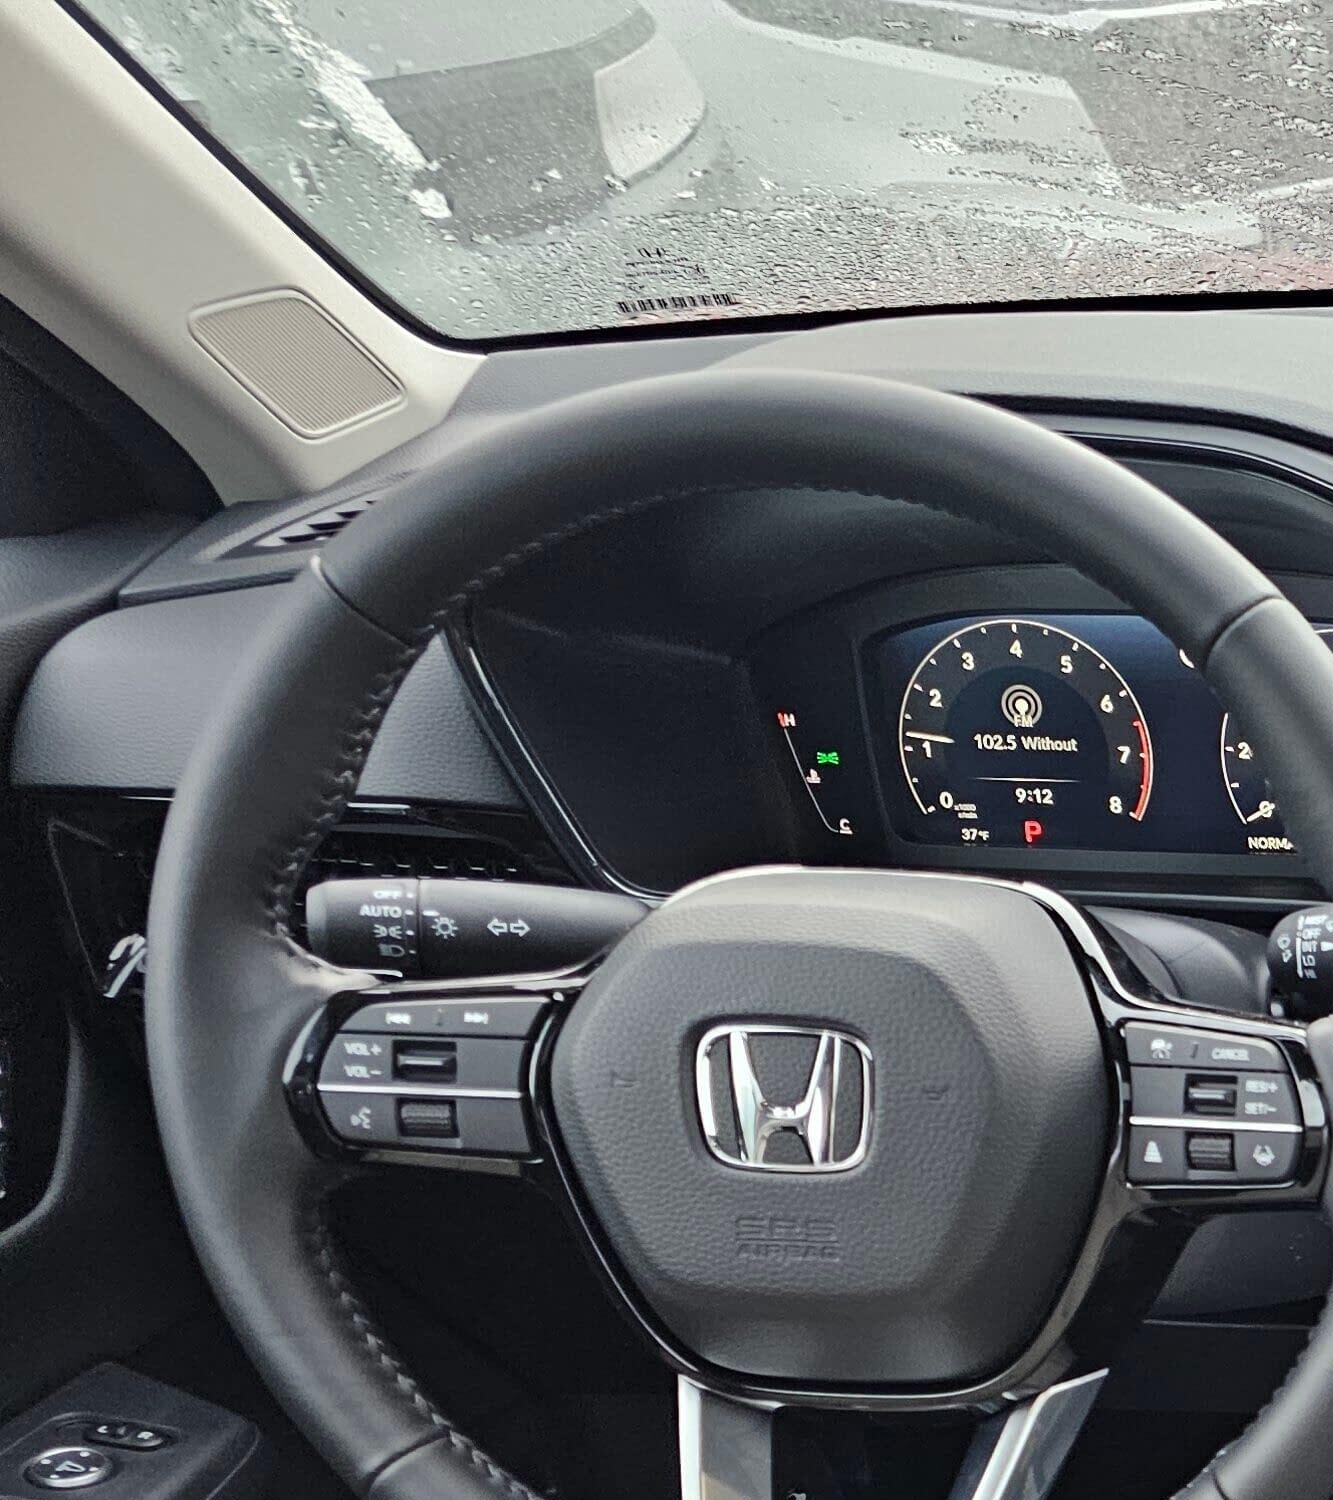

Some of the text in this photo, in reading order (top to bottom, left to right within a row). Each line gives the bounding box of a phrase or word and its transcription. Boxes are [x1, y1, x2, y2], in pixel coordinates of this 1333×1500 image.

[1009, 640, 1023, 658] 4
[961, 652, 975, 670] 3
[1060, 655, 1073, 673] 5
[929, 688, 943, 707] 2
[1100, 694, 1114, 713] 6
[1014, 714, 1034, 728] FM
[922, 741, 932, 758] 1
[974, 733, 1079, 753] 102.5 Without
[1117, 745, 1131, 764] 7
[939, 791, 954, 809] 0
[1015, 787, 1054, 805] 9:12
[1109, 796, 1123, 814] 8
[1024, 820, 1043, 843] P
[359, 904, 402, 919] AUTO
